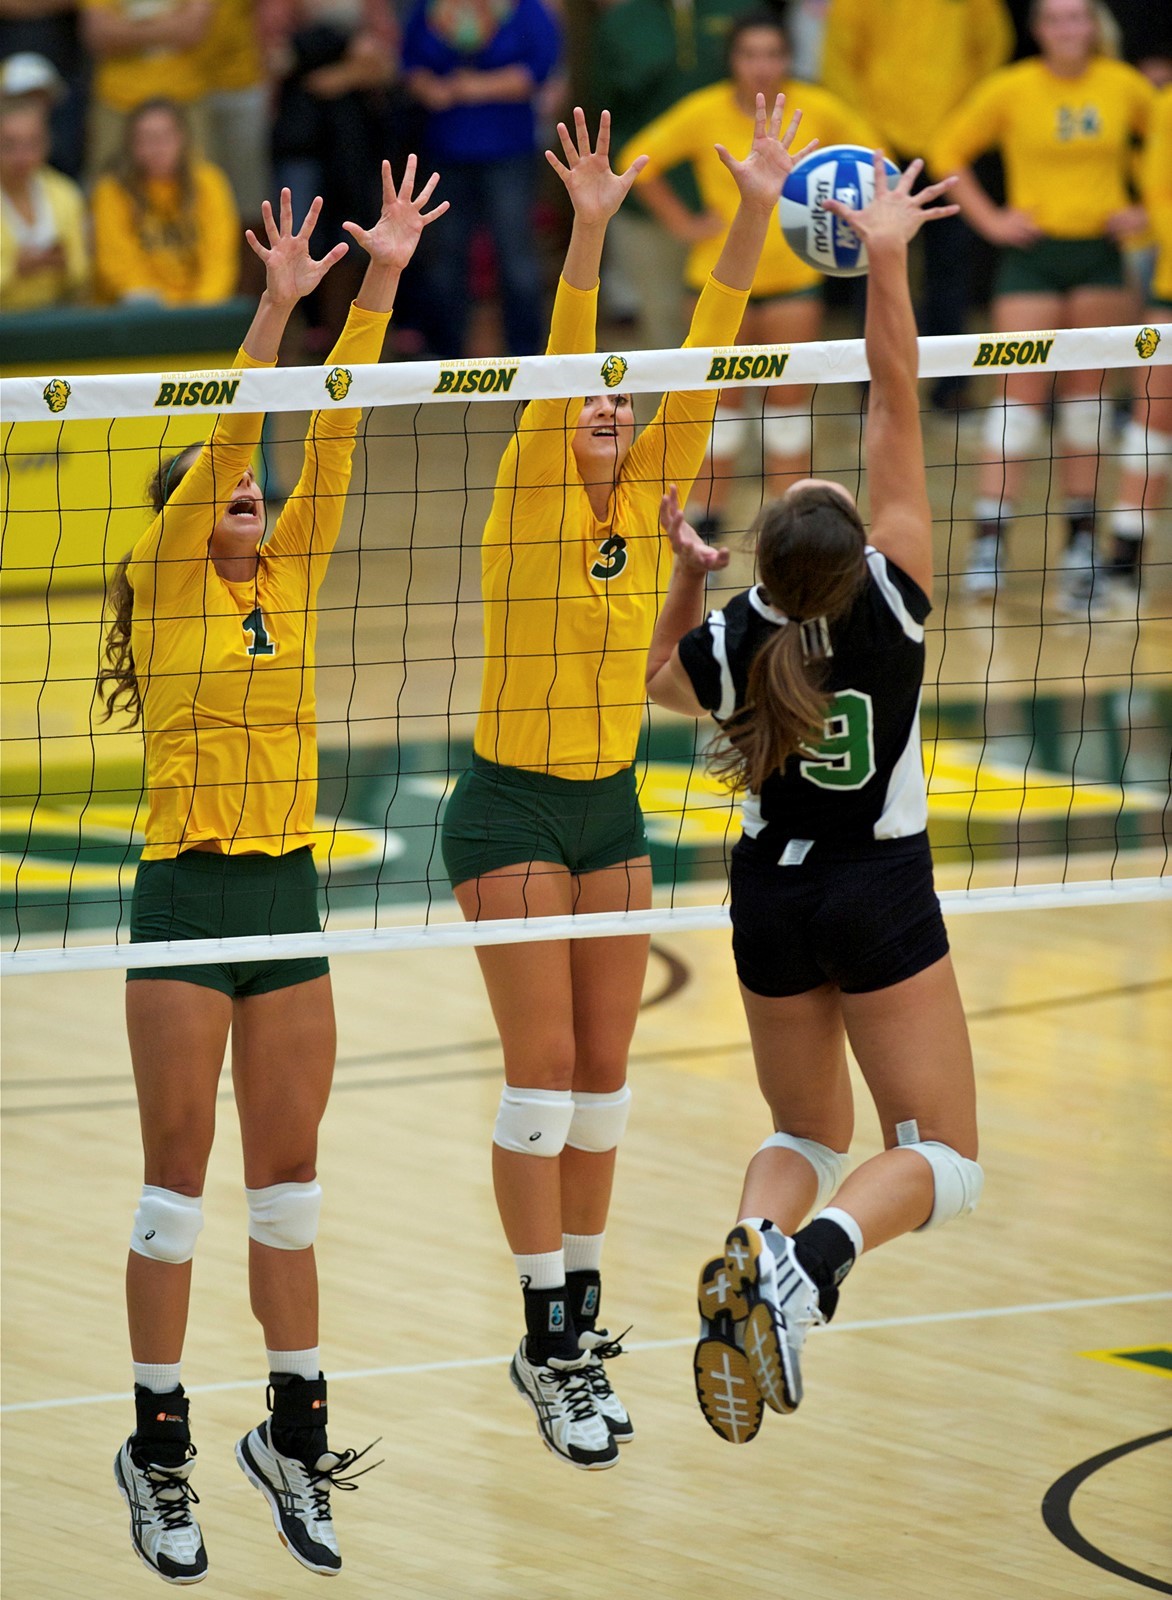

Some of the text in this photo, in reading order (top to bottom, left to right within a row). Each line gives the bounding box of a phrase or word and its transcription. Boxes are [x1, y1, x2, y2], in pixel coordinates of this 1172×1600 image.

[811, 181, 830, 253] molten
[467, 359, 496, 367] DAKOTA
[973, 338, 1055, 367] BISON
[189, 371, 220, 379] DAKOTA
[432, 367, 518, 394] BISON
[705, 353, 789, 382] BISON
[153, 379, 241, 408] BISON
[590, 533, 628, 581] 3
[242, 607, 275, 656] 1
[799, 688, 877, 791] 9
